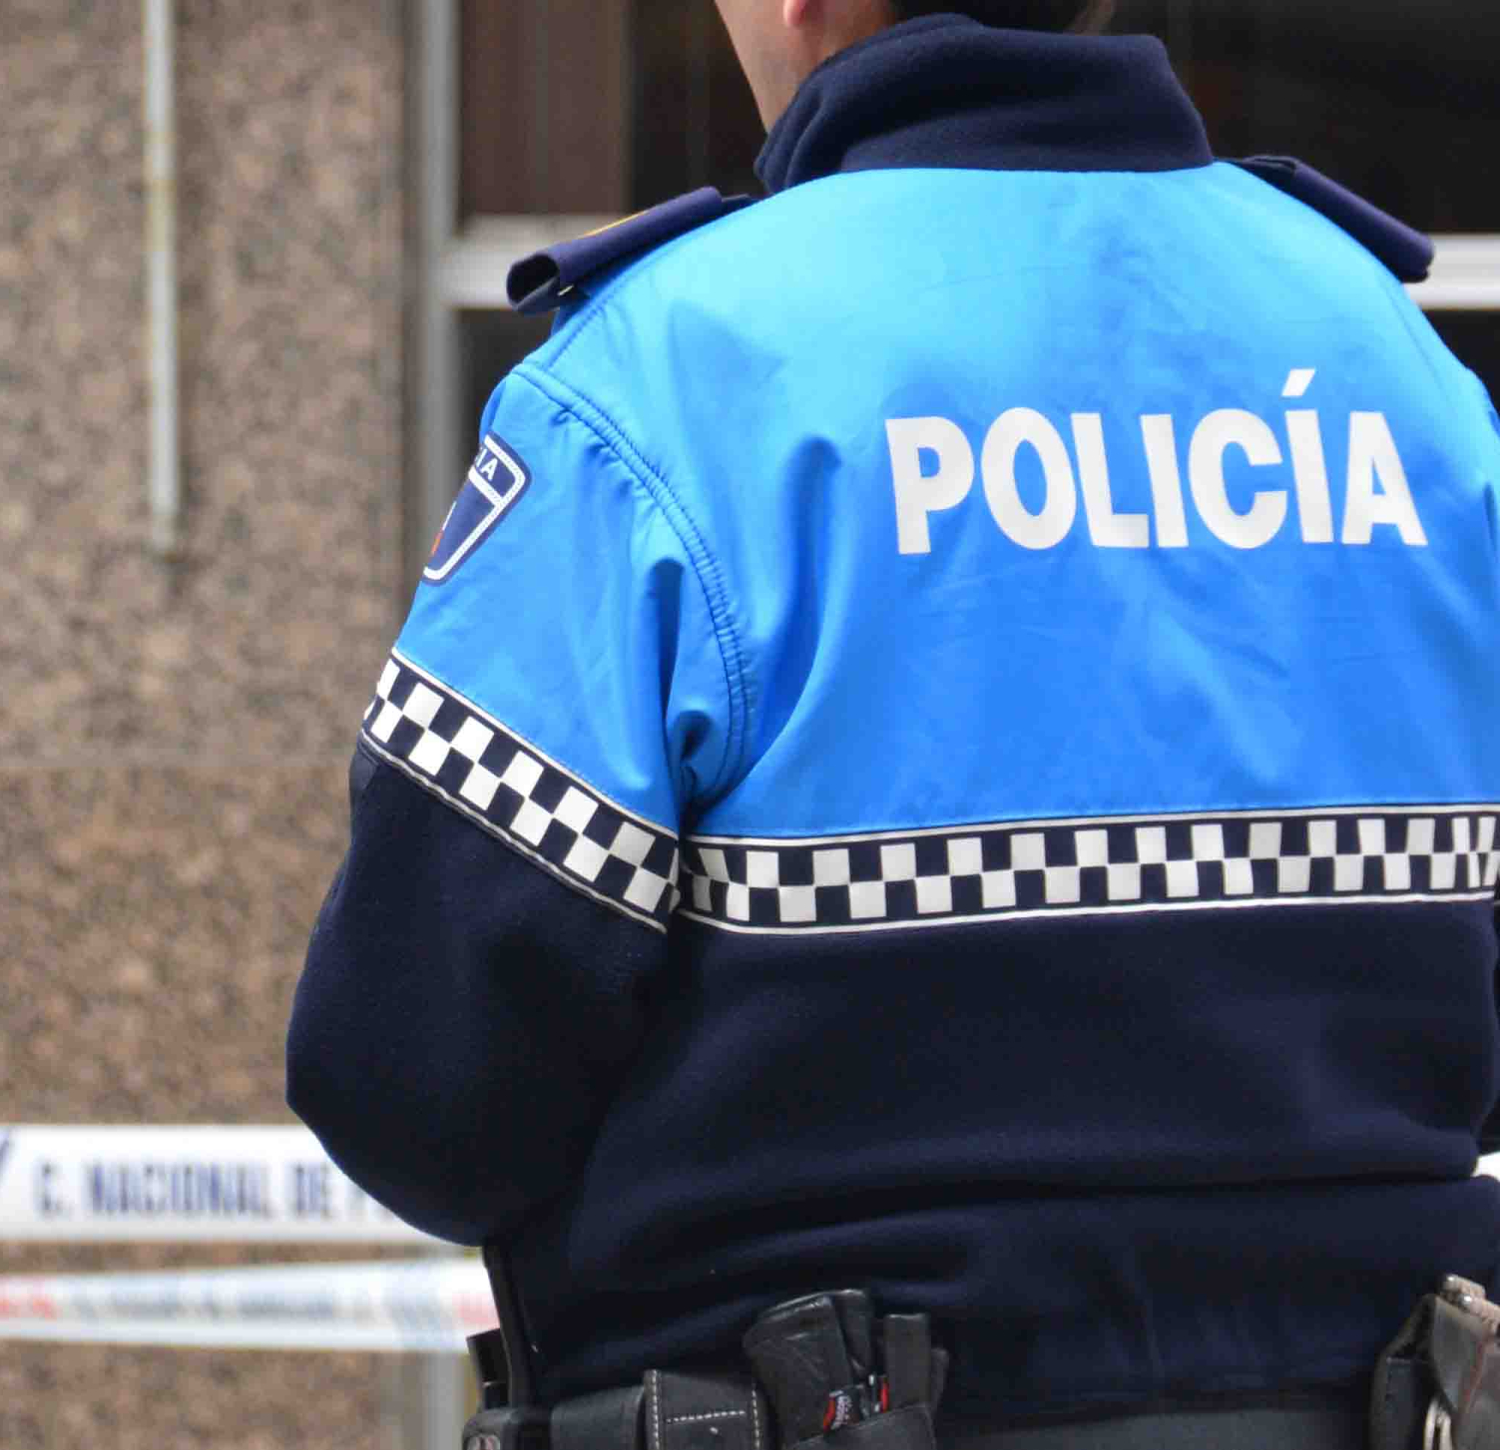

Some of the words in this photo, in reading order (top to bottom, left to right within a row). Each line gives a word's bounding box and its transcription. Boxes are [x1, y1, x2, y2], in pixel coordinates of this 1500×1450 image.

[475, 447, 499, 482] IA
[884, 368, 1429, 555] POLICÍA
[86, 1159, 273, 1217] NACIONAL
[290, 1159, 333, 1217] DE
